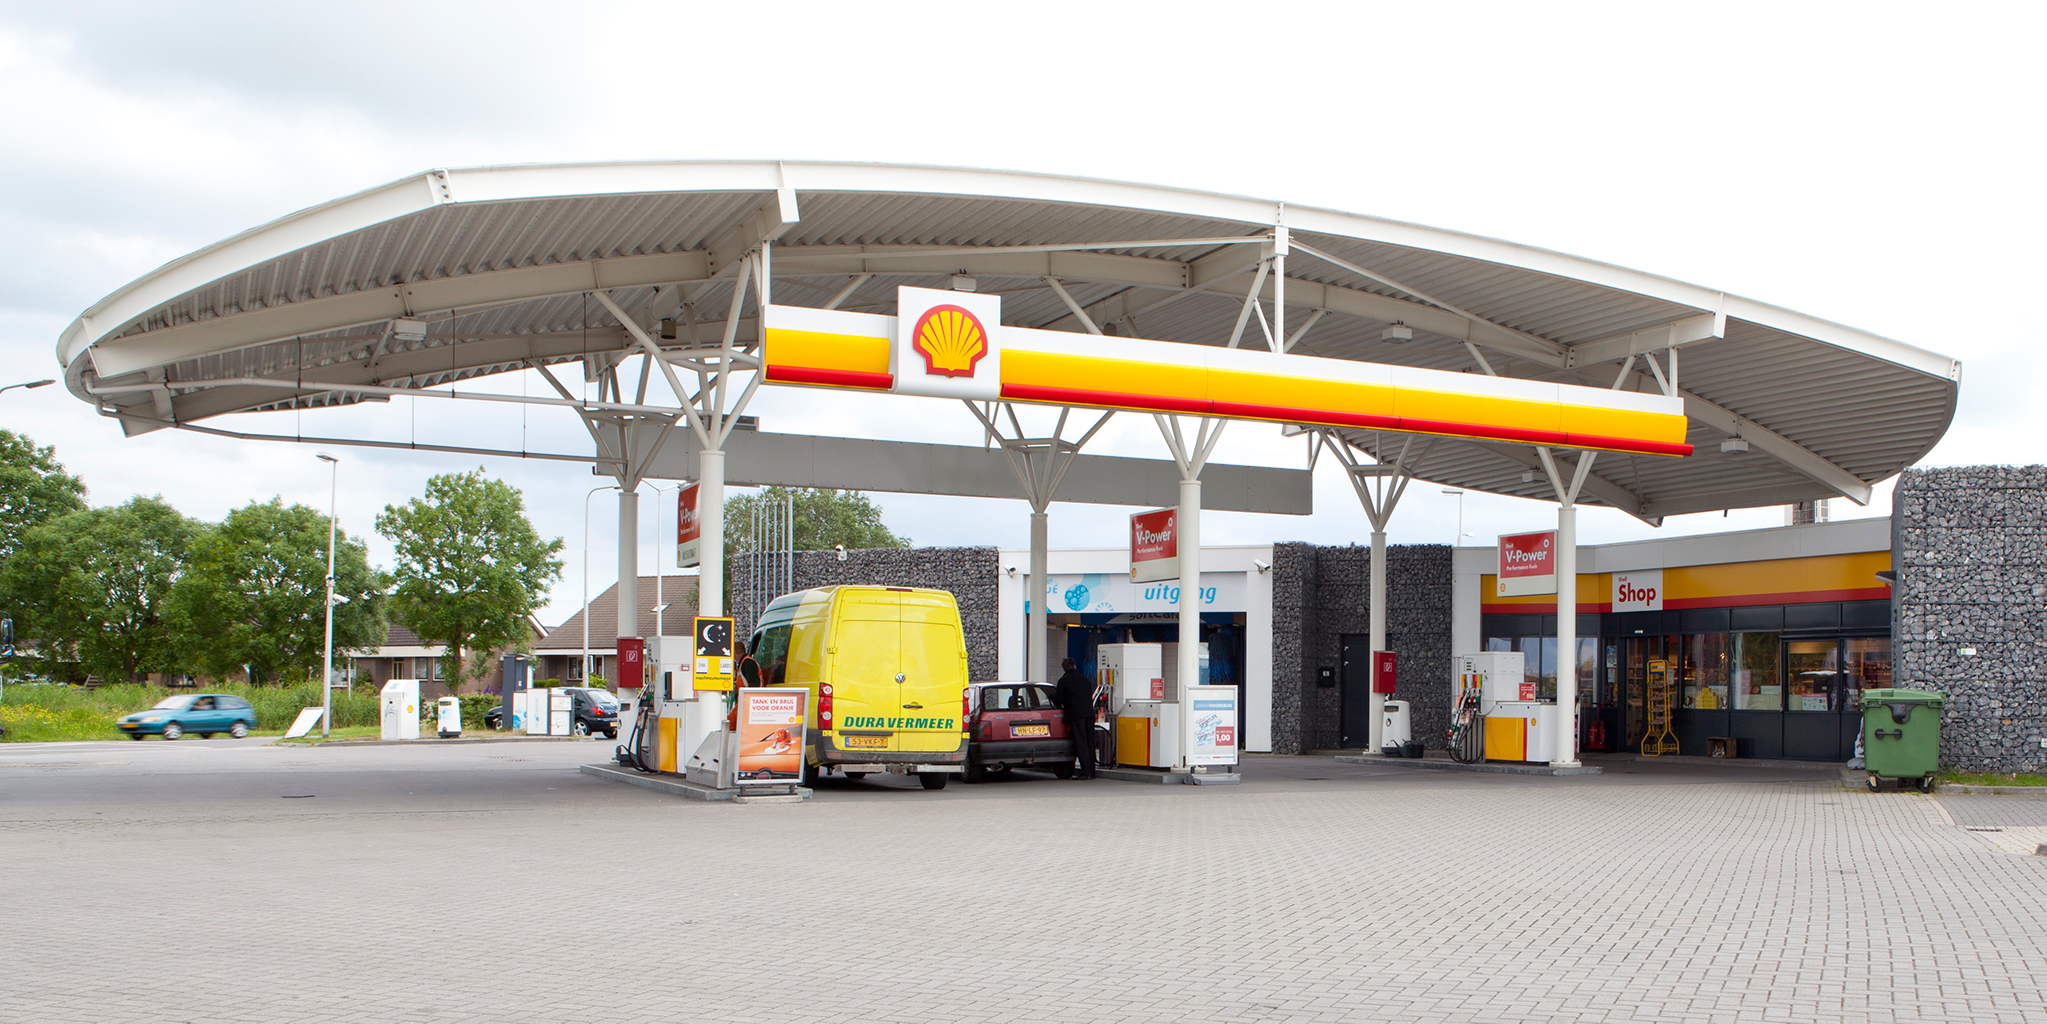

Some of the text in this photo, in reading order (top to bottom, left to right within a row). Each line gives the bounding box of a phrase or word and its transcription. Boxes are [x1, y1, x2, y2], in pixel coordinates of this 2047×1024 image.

[1136, 530, 1171, 545] V-Power
[1506, 550, 1547, 563] V-Power
[1144, 584, 1216, 604] uitgng
[1618, 583, 1656, 606] Shop
[844, 716, 954, 729] DURA VERMEER
[852, 738, 884, 746] 53-VKF-7
[1216, 734, 1230, 742] 1,00
